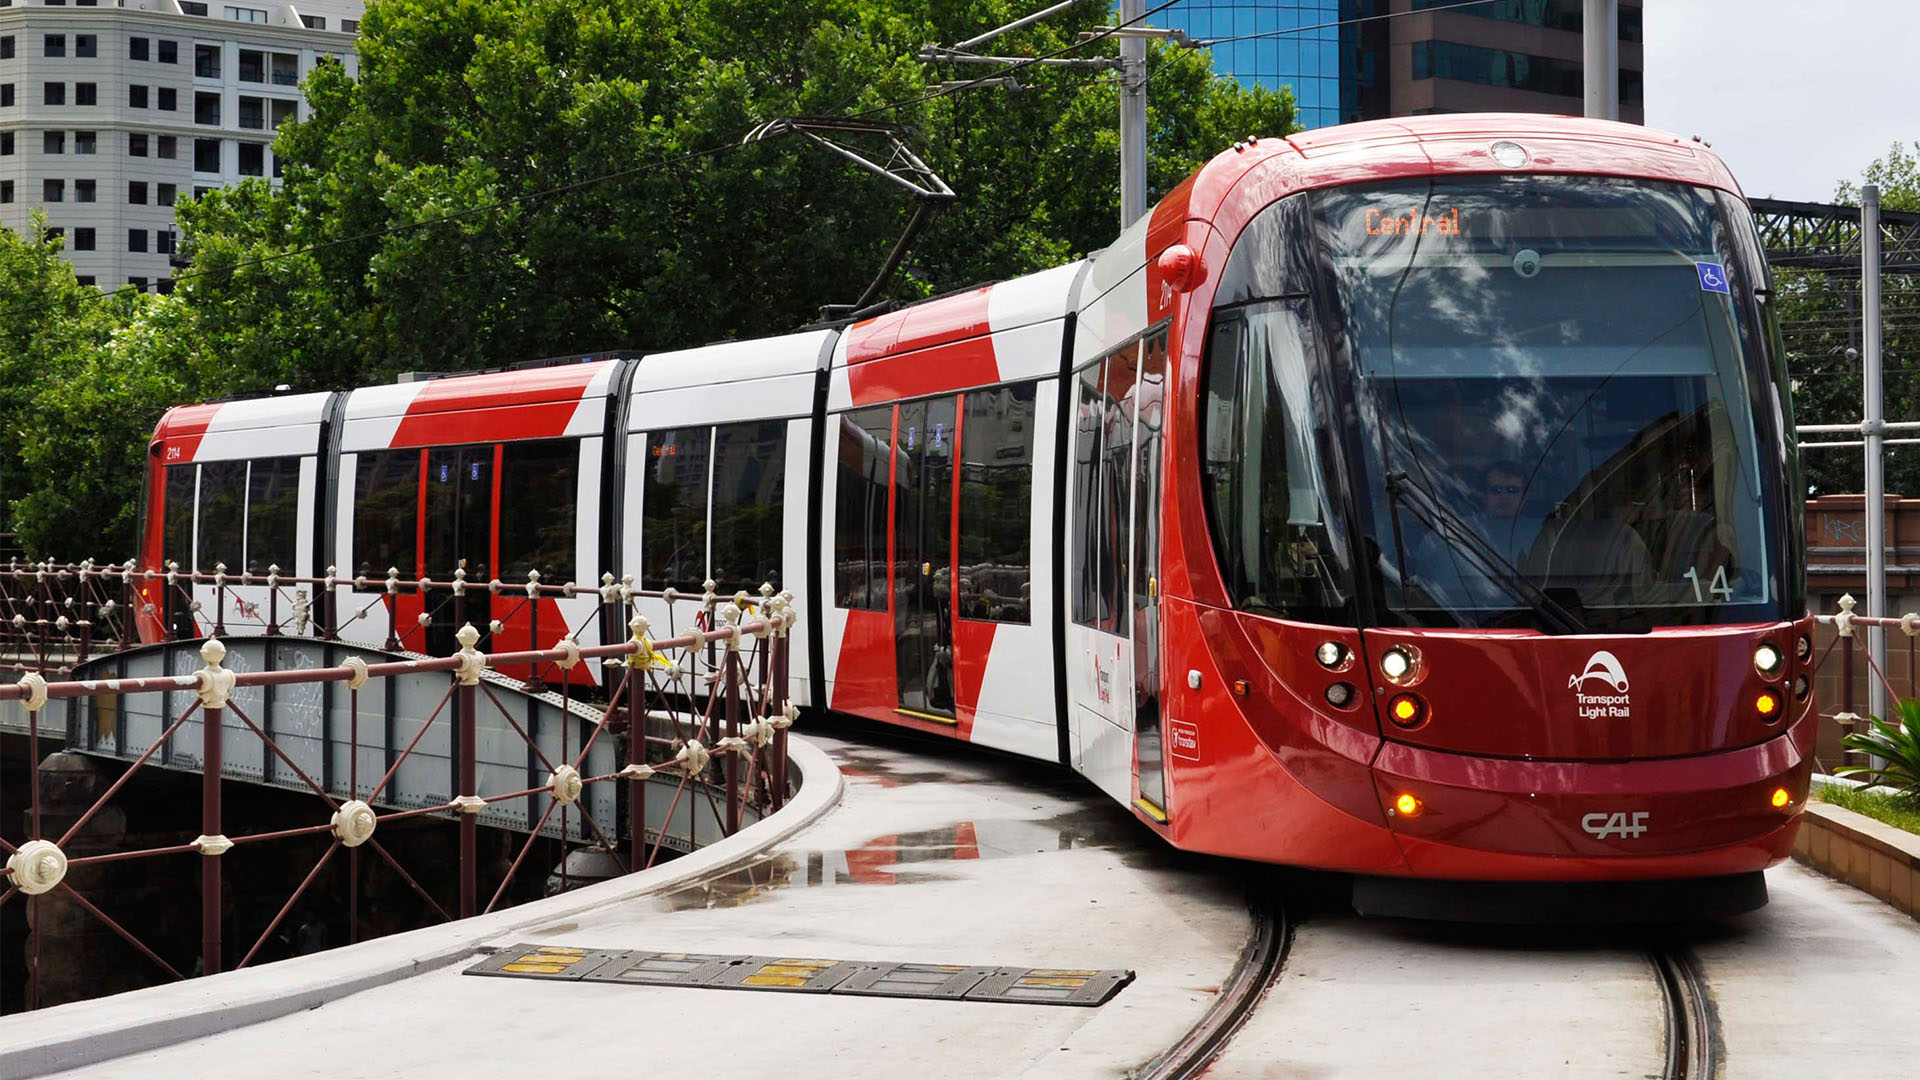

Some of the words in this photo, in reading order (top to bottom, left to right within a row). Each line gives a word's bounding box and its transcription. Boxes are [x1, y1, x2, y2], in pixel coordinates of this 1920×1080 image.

[1366, 207, 1460, 236] Central
[167, 446, 181, 460] 2114
[1683, 565, 1734, 602] 14
[1576, 693, 1630, 706] Transport
[1579, 706, 1607, 720] Light
[1609, 706, 1630, 717] Rail
[1581, 811, 1650, 840] CAF
